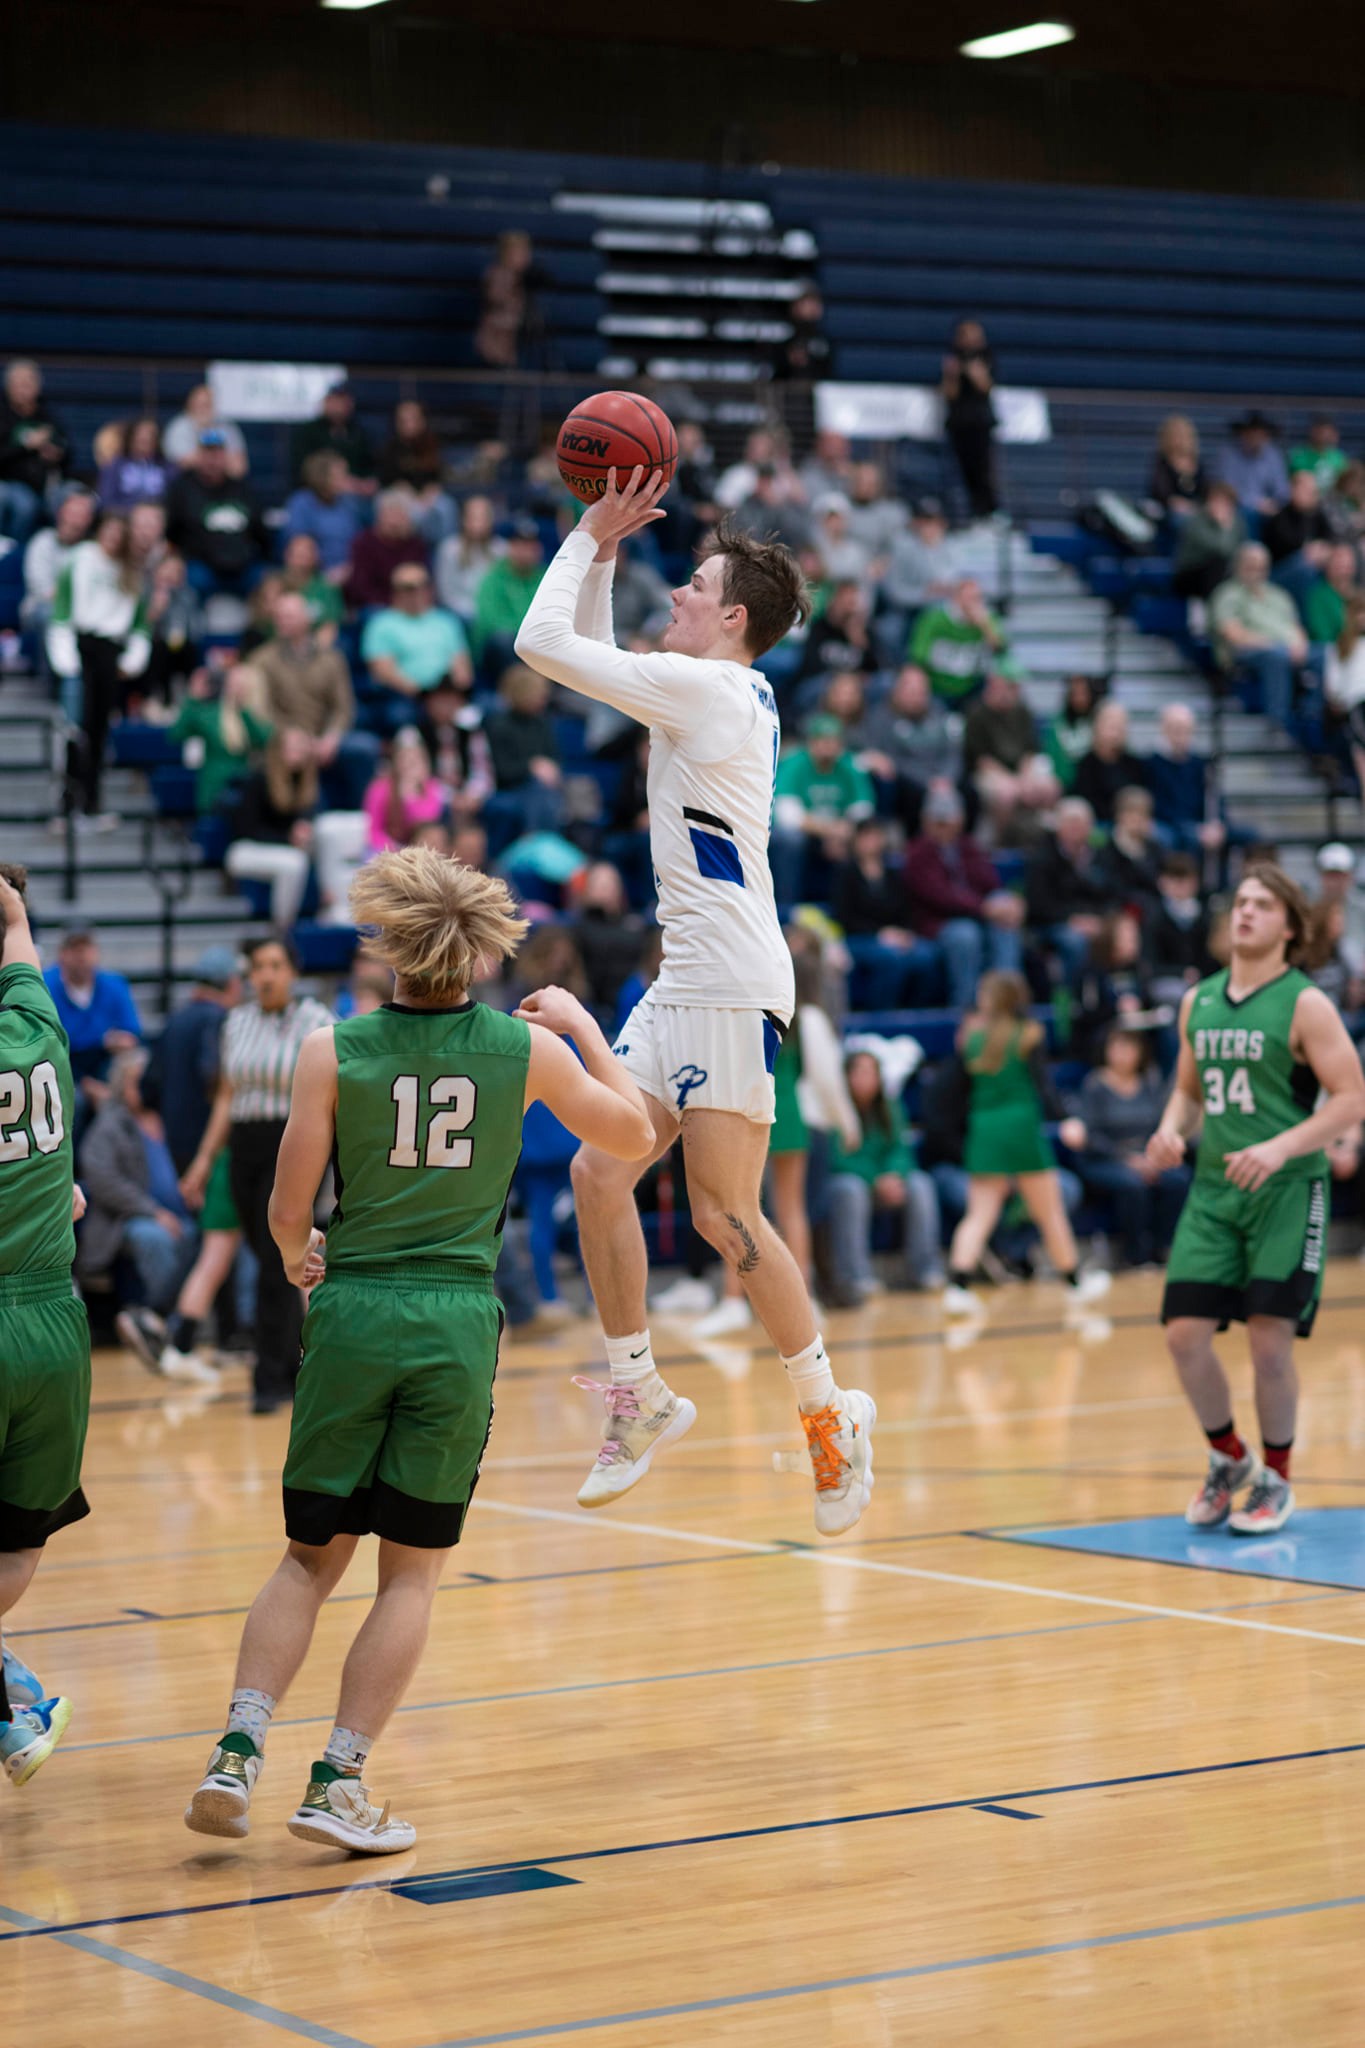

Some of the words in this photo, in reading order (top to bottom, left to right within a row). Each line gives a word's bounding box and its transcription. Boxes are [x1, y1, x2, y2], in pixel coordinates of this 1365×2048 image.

[561, 432, 610, 458] NCAA
[0, 1060, 65, 1164] 20
[387, 1074, 477, 1168] 12
[1203, 1067, 1256, 1116] 34
